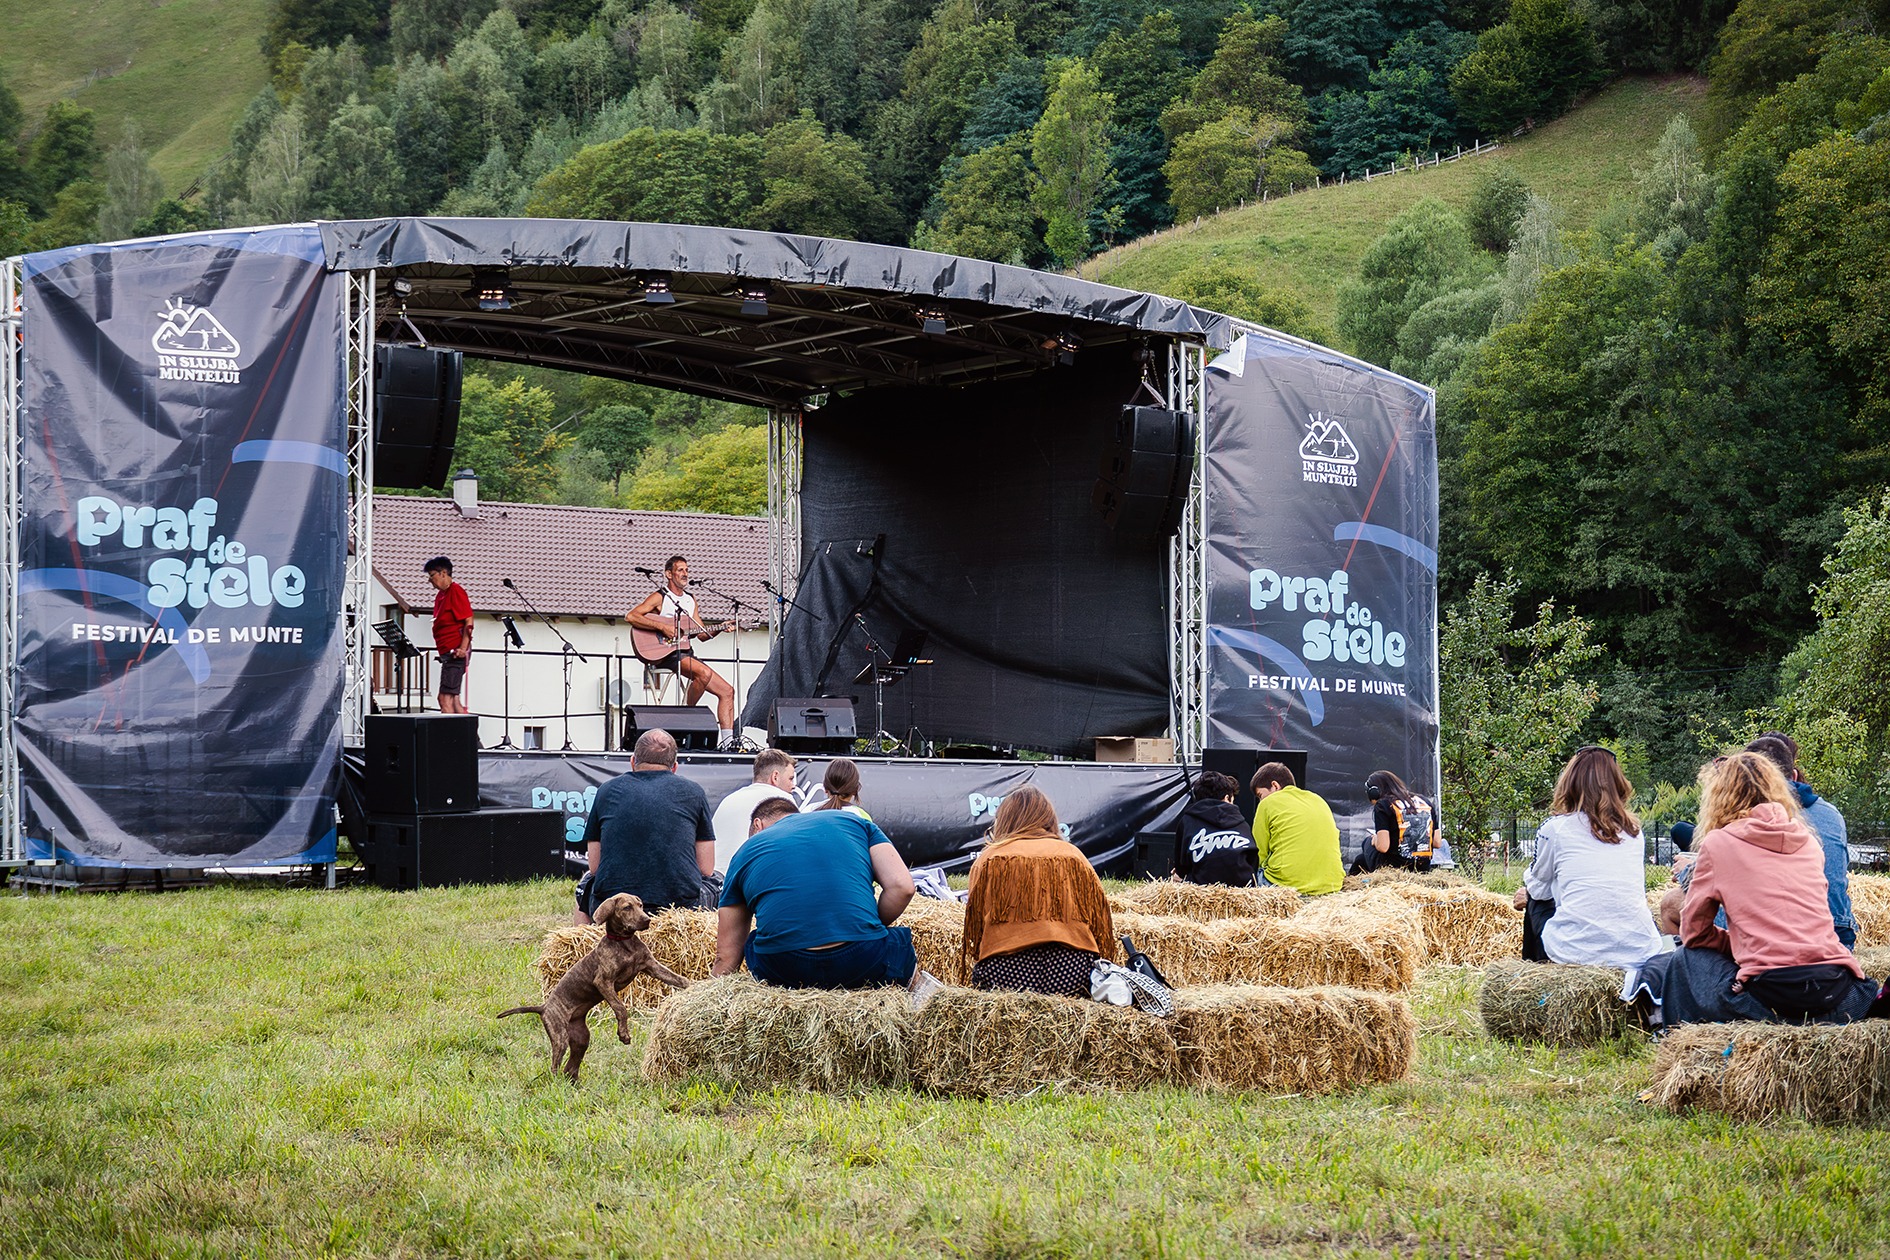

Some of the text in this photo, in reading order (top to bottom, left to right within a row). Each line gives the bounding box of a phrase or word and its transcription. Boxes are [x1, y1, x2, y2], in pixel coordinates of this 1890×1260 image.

[158, 355, 240, 371] IN SLUJBA
[159, 367, 240, 384] MUNTELUI
[1302, 460, 1358, 477] IN SLUJBA
[1303, 471, 1358, 487] MUNTELUI
[77, 496, 218, 551] Praf
[208, 534, 246, 564] de
[147, 554, 306, 609] Stele
[1249, 568, 1349, 614] Praf
[1346, 601, 1372, 627] de
[72, 623, 304, 644] FESTIVAL DE MUNTE
[1302, 619, 1406, 667] Stele
[1248, 674, 1407, 697] FESTIVAL DE MUNTE
